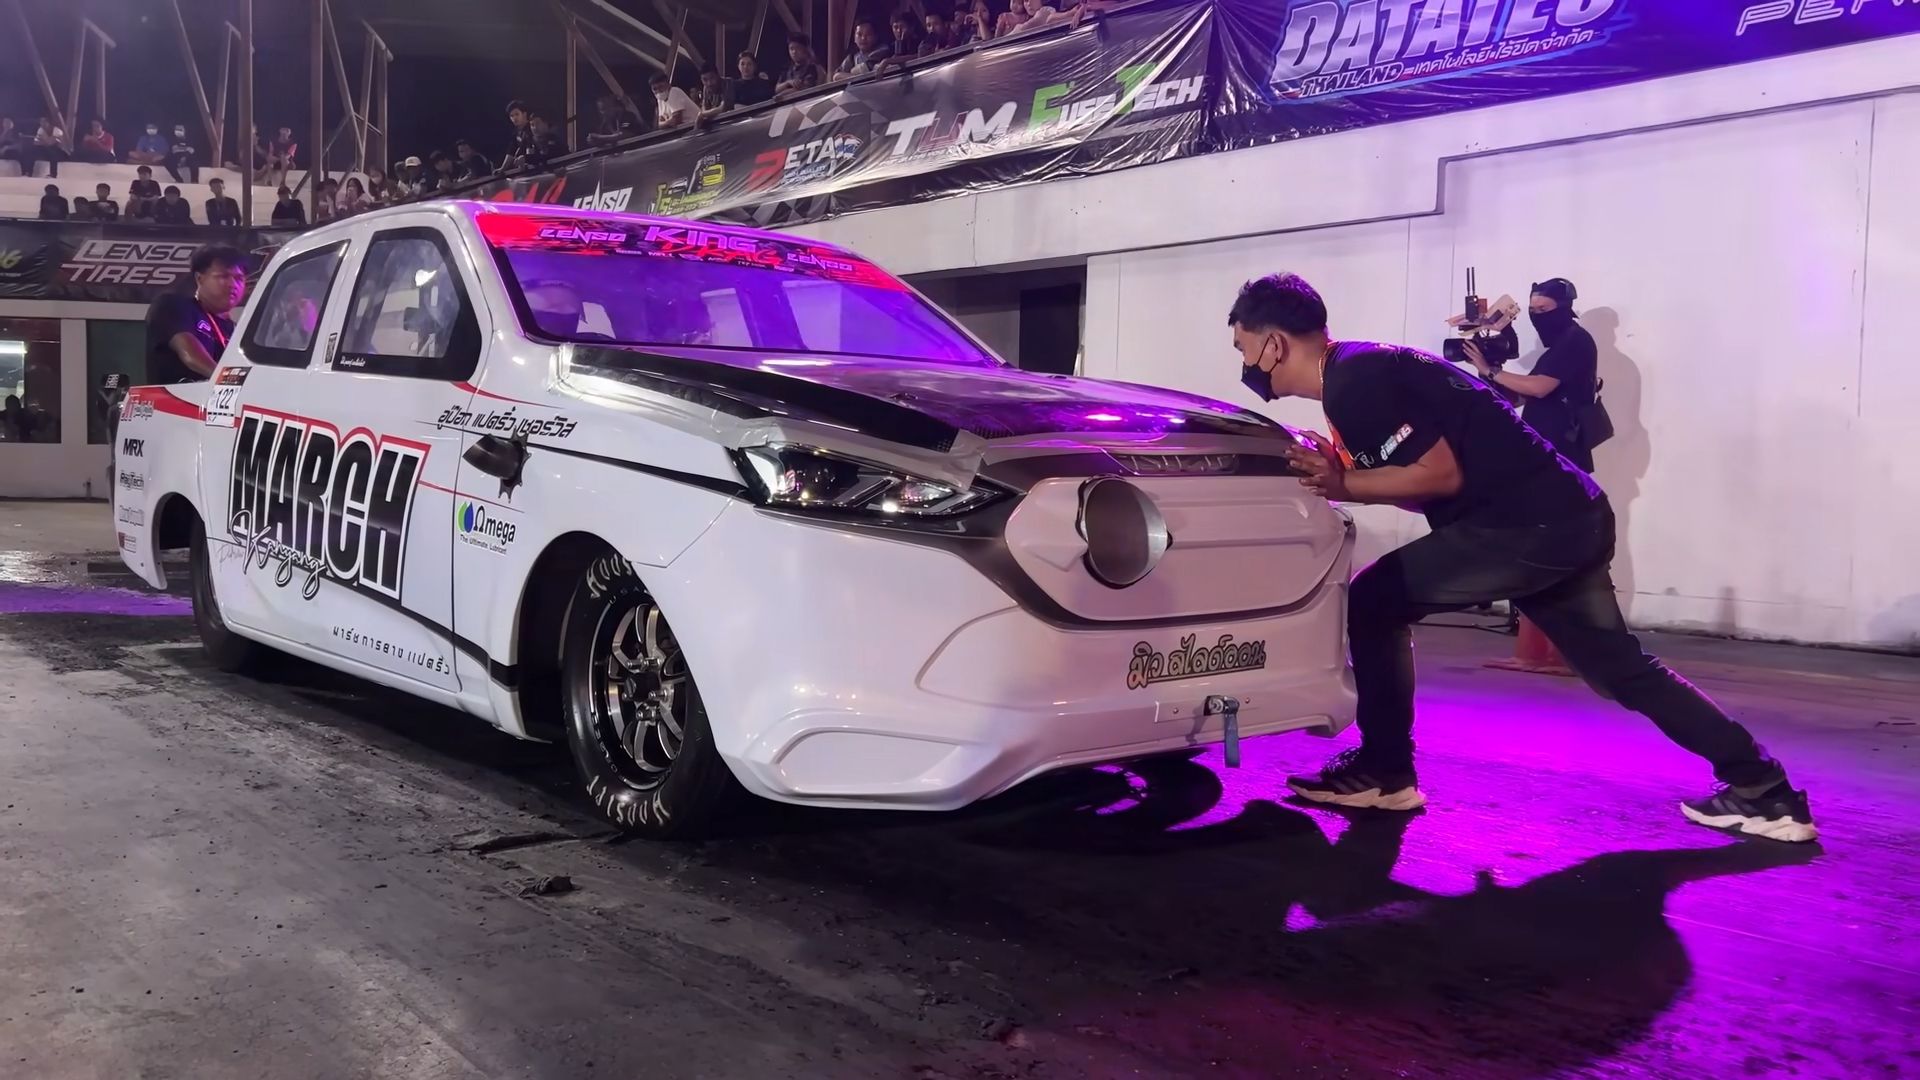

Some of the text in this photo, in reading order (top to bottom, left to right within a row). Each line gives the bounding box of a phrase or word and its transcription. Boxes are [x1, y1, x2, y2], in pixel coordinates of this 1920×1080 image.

[1300, 62, 1404, 98] THAILAND
[644, 226, 759, 254] KING
[61, 264, 191, 285] TIRES
[215, 388, 235, 410] 122
[123, 438, 145, 457] MRX
[230, 407, 428, 603] MARCH
